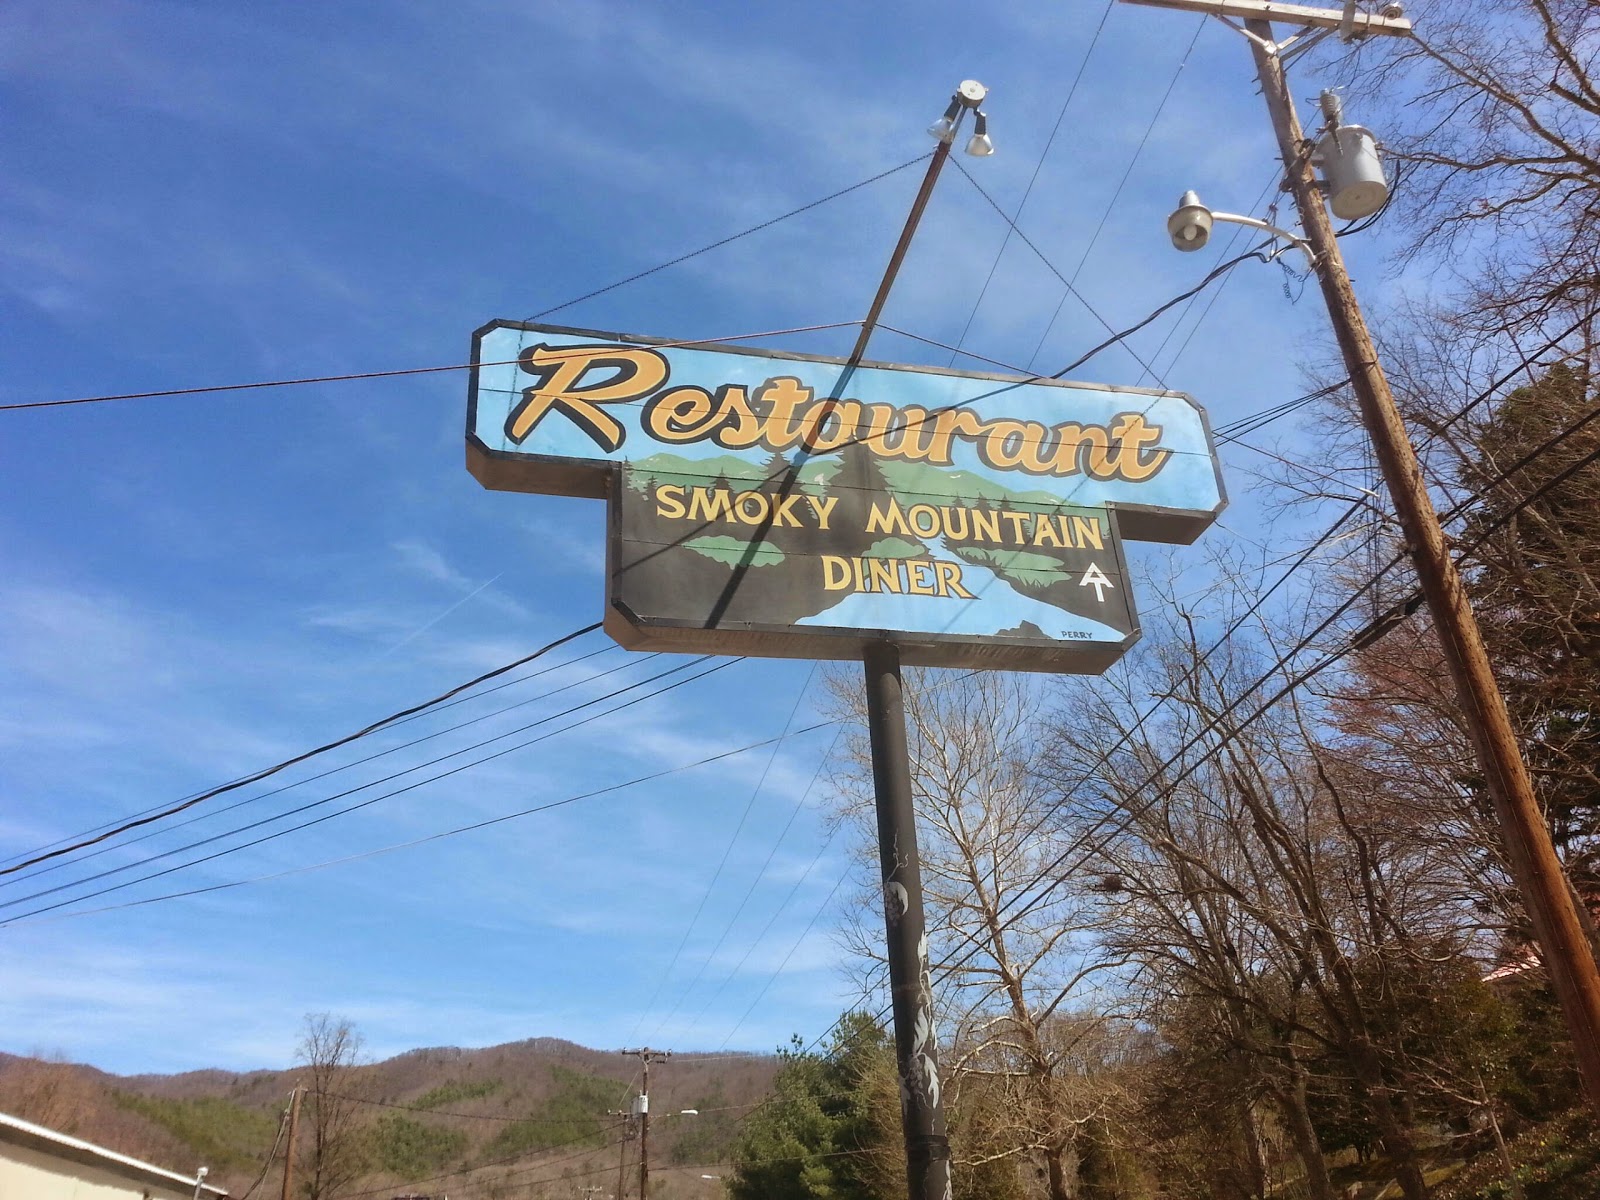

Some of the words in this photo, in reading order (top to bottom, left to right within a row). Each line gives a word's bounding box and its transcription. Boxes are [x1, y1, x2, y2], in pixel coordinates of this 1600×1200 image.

[504, 342, 1174, 483] Restaurant
[655, 484, 838, 529] SMOKY
[865, 497, 1104, 550] MOUNTAIN
[821, 555, 978, 600] DINER
[1061, 631, 1093, 640] PERRY
